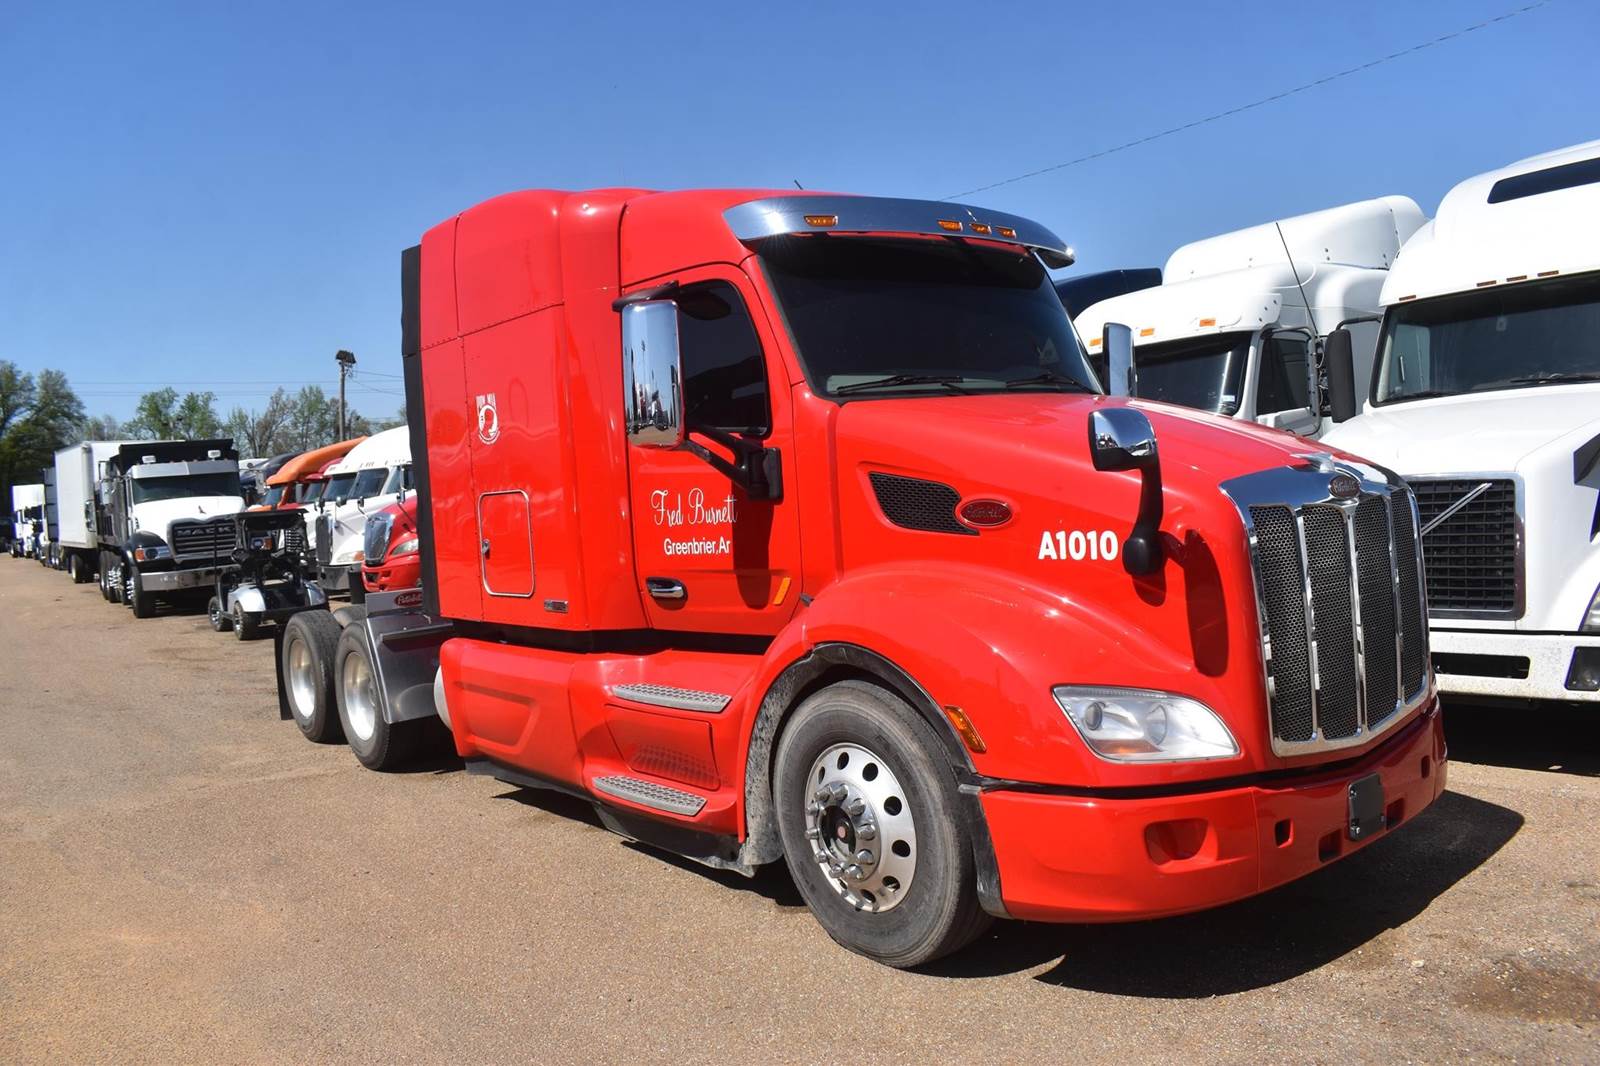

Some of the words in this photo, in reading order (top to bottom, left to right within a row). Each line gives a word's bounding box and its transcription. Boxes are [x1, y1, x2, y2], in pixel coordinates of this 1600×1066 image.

[651, 489, 684, 527] Fred
[687, 488, 738, 525] Burnett
[1038, 530, 1119, 561] A1010
